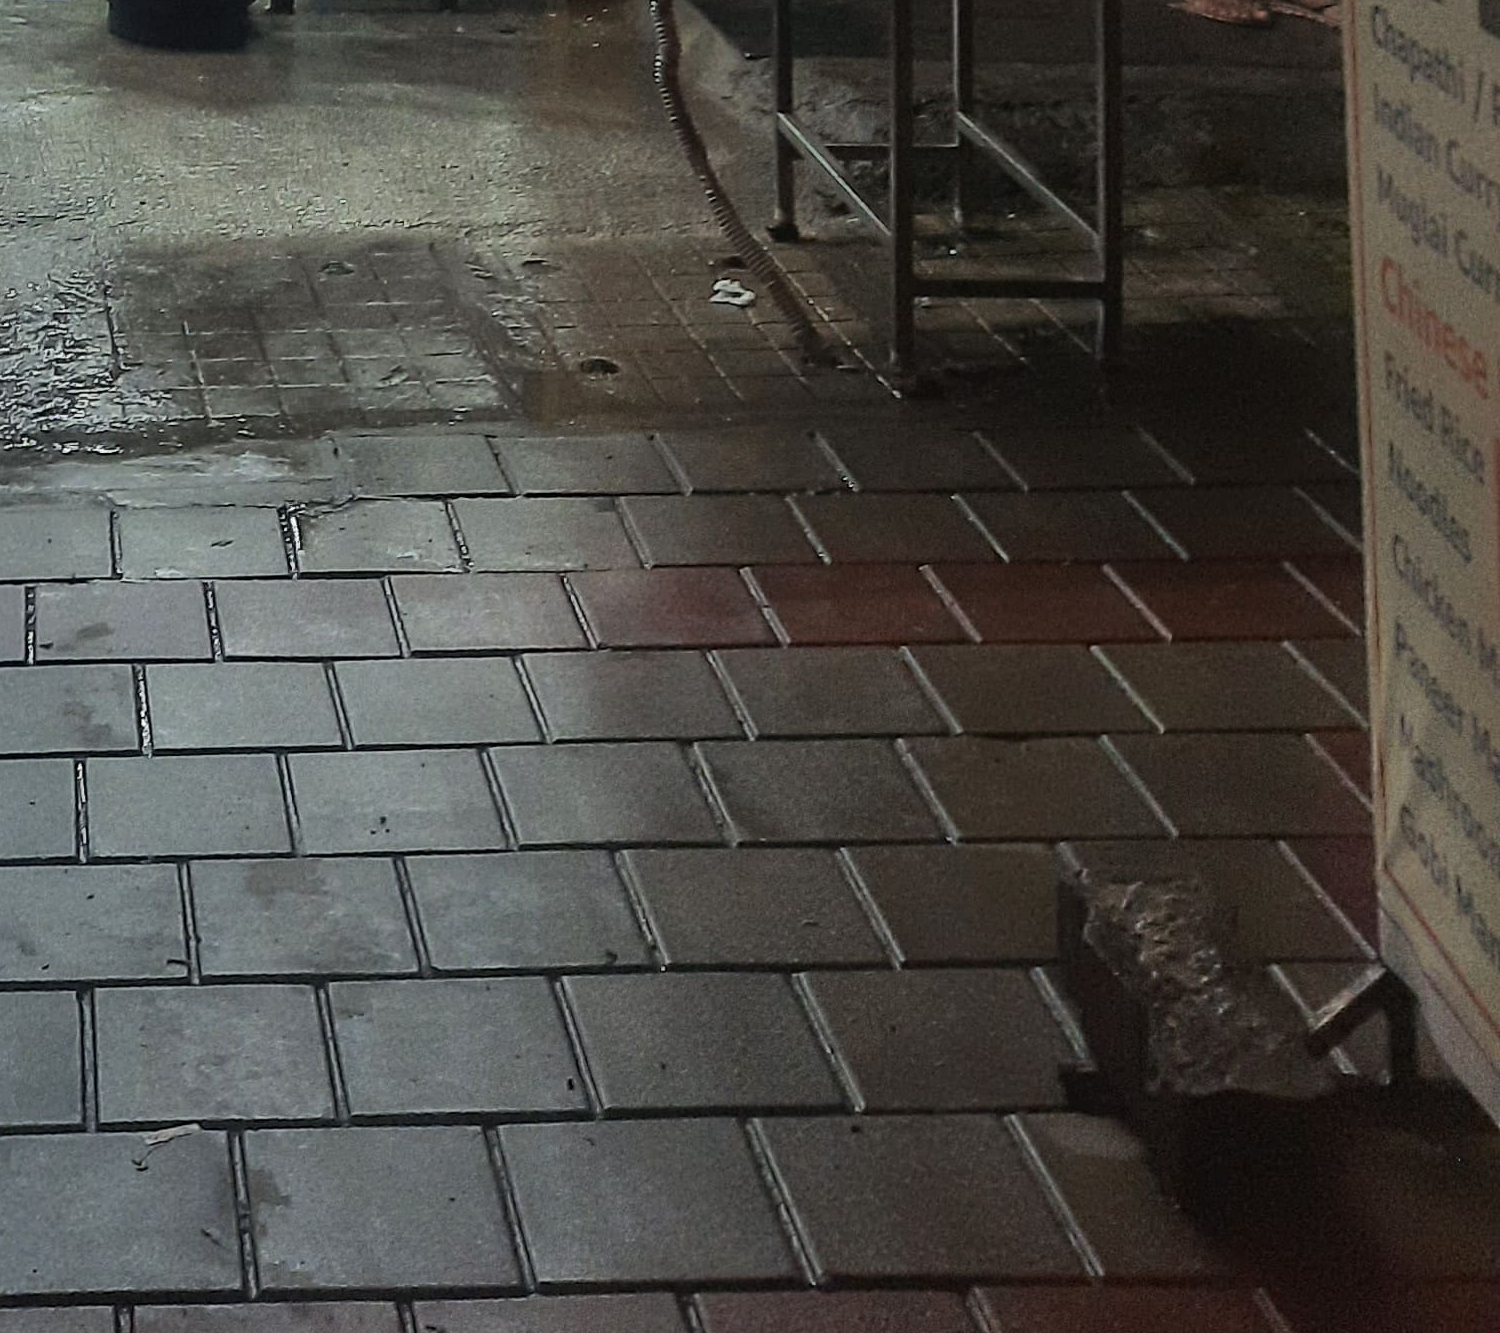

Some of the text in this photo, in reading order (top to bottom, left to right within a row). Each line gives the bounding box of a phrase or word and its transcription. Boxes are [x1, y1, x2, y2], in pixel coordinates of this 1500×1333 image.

[1373, 82, 1440, 167] Indian
[1380, 256, 1489, 401] Chinese
[1384, 349, 1485, 486] Fried Rice
[1388, 440, 1471, 564] Noodles
[1393, 533, 1471, 656] Chicken
